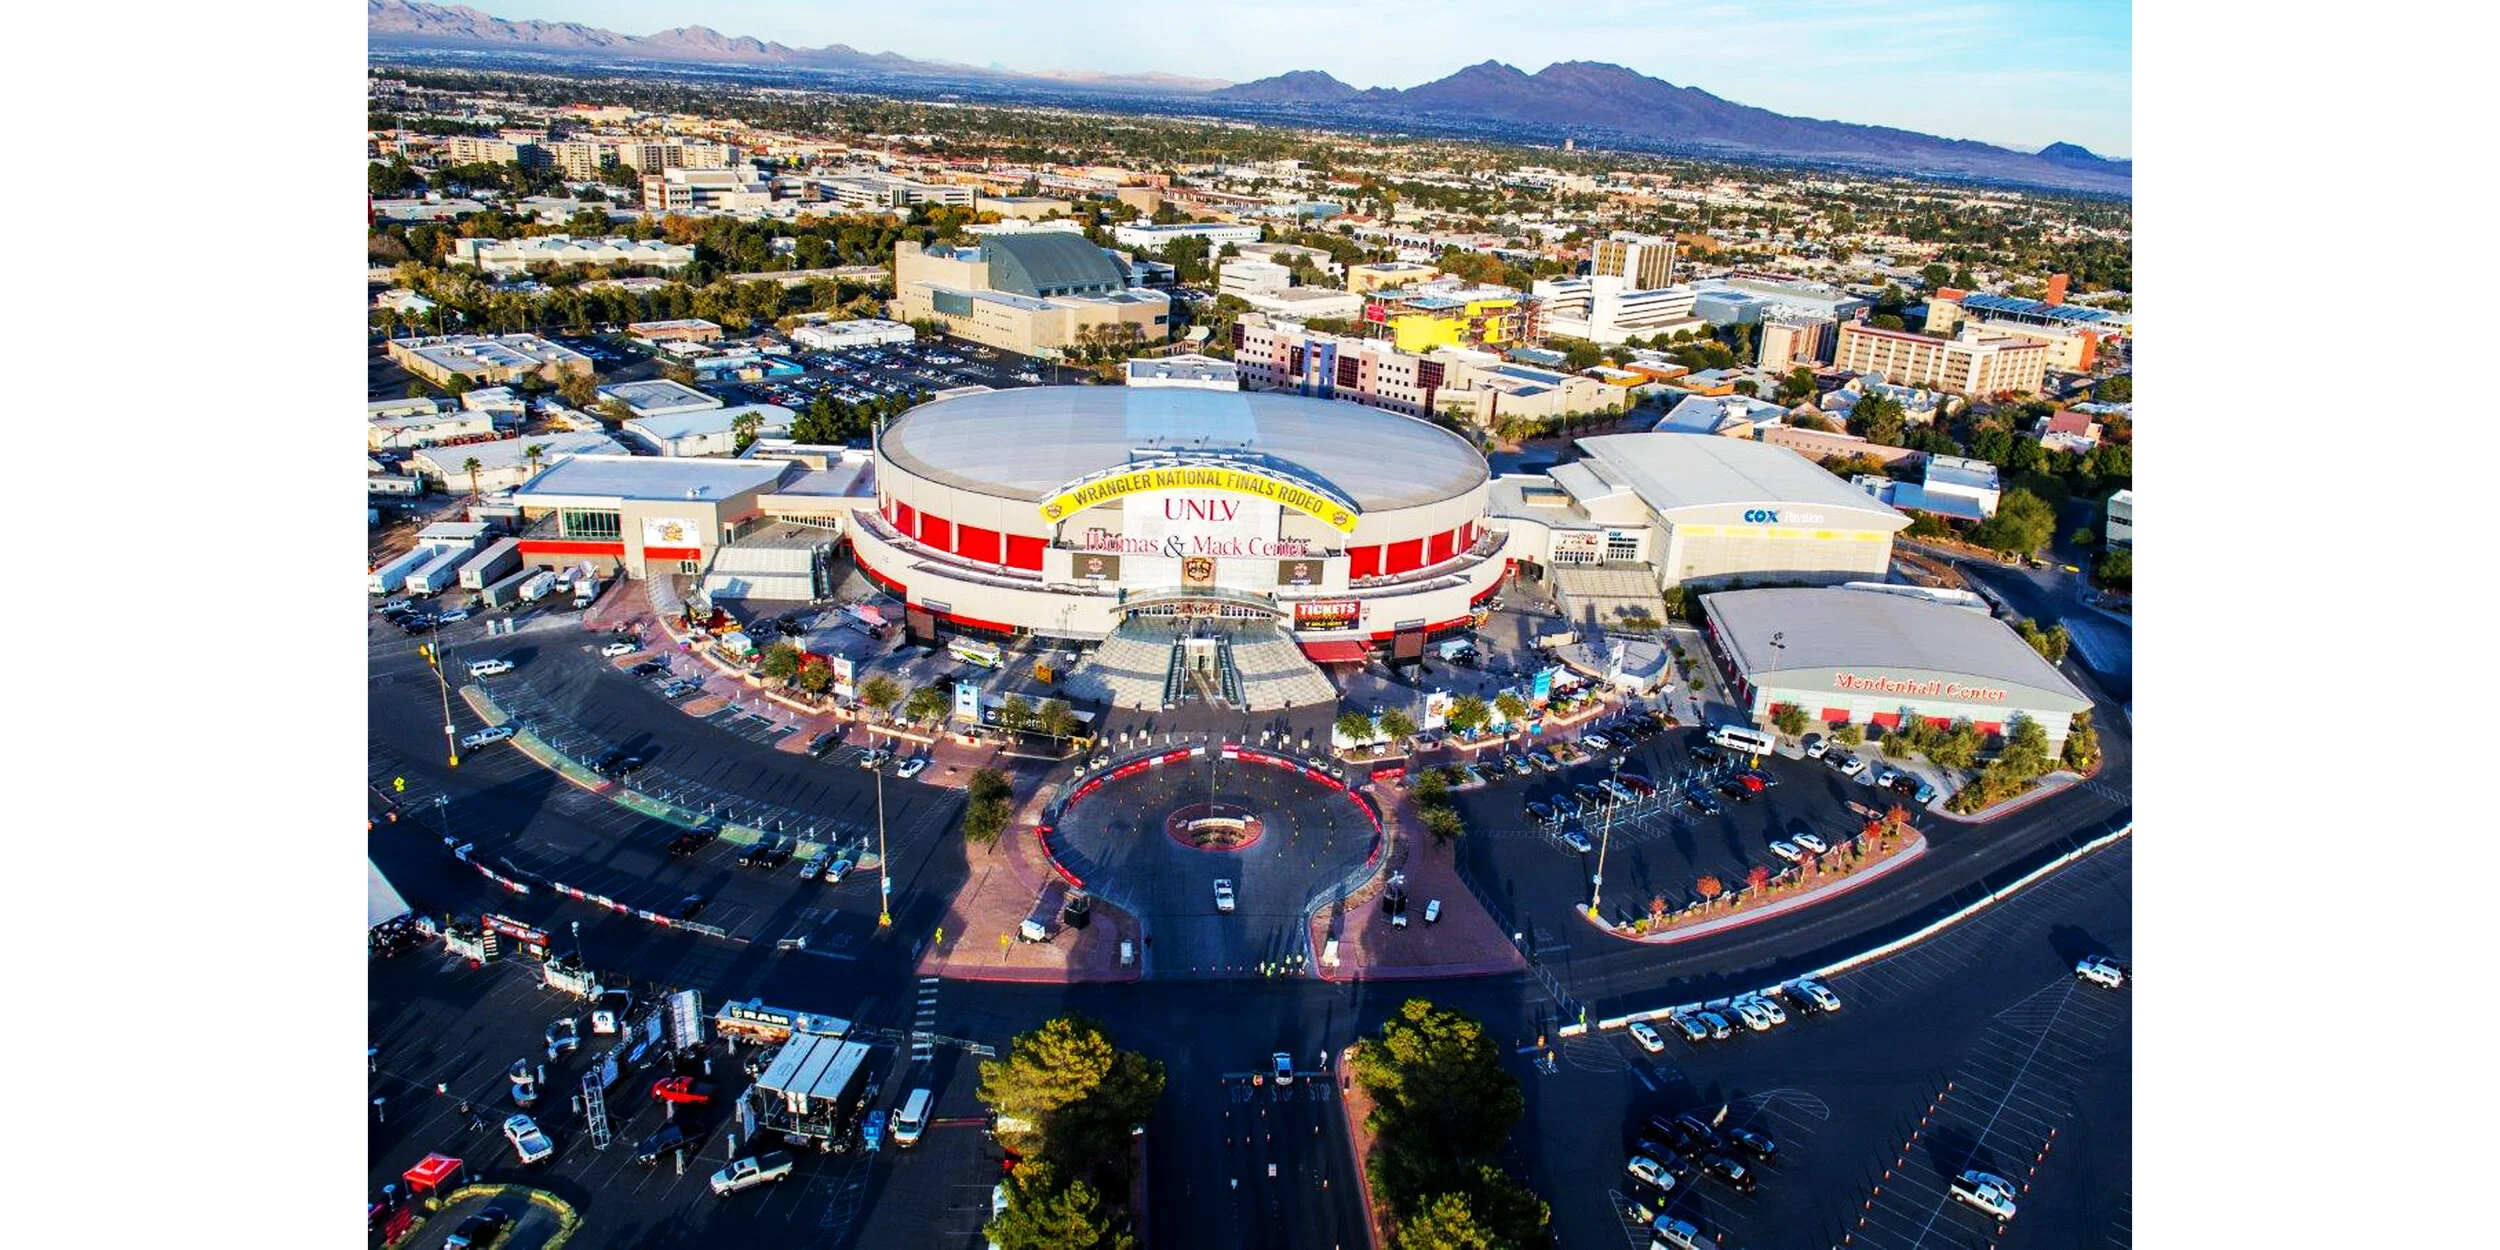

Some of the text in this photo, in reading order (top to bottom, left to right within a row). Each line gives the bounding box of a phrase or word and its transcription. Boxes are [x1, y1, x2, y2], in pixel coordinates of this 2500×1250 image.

[1074, 470, 1323, 514] WRANGLER NATIONAL FINALS RODEO
[1164, 498, 1240, 521] UNLV
[1744, 509, 1824, 524] COX Pavilion
[1082, 531, 1311, 558] Thomas & Mack Center
[1299, 603, 1356, 615] TICKETS
[1836, 673, 2006, 701] Mendenhall Center
[743, 1009, 789, 1025] RAM
